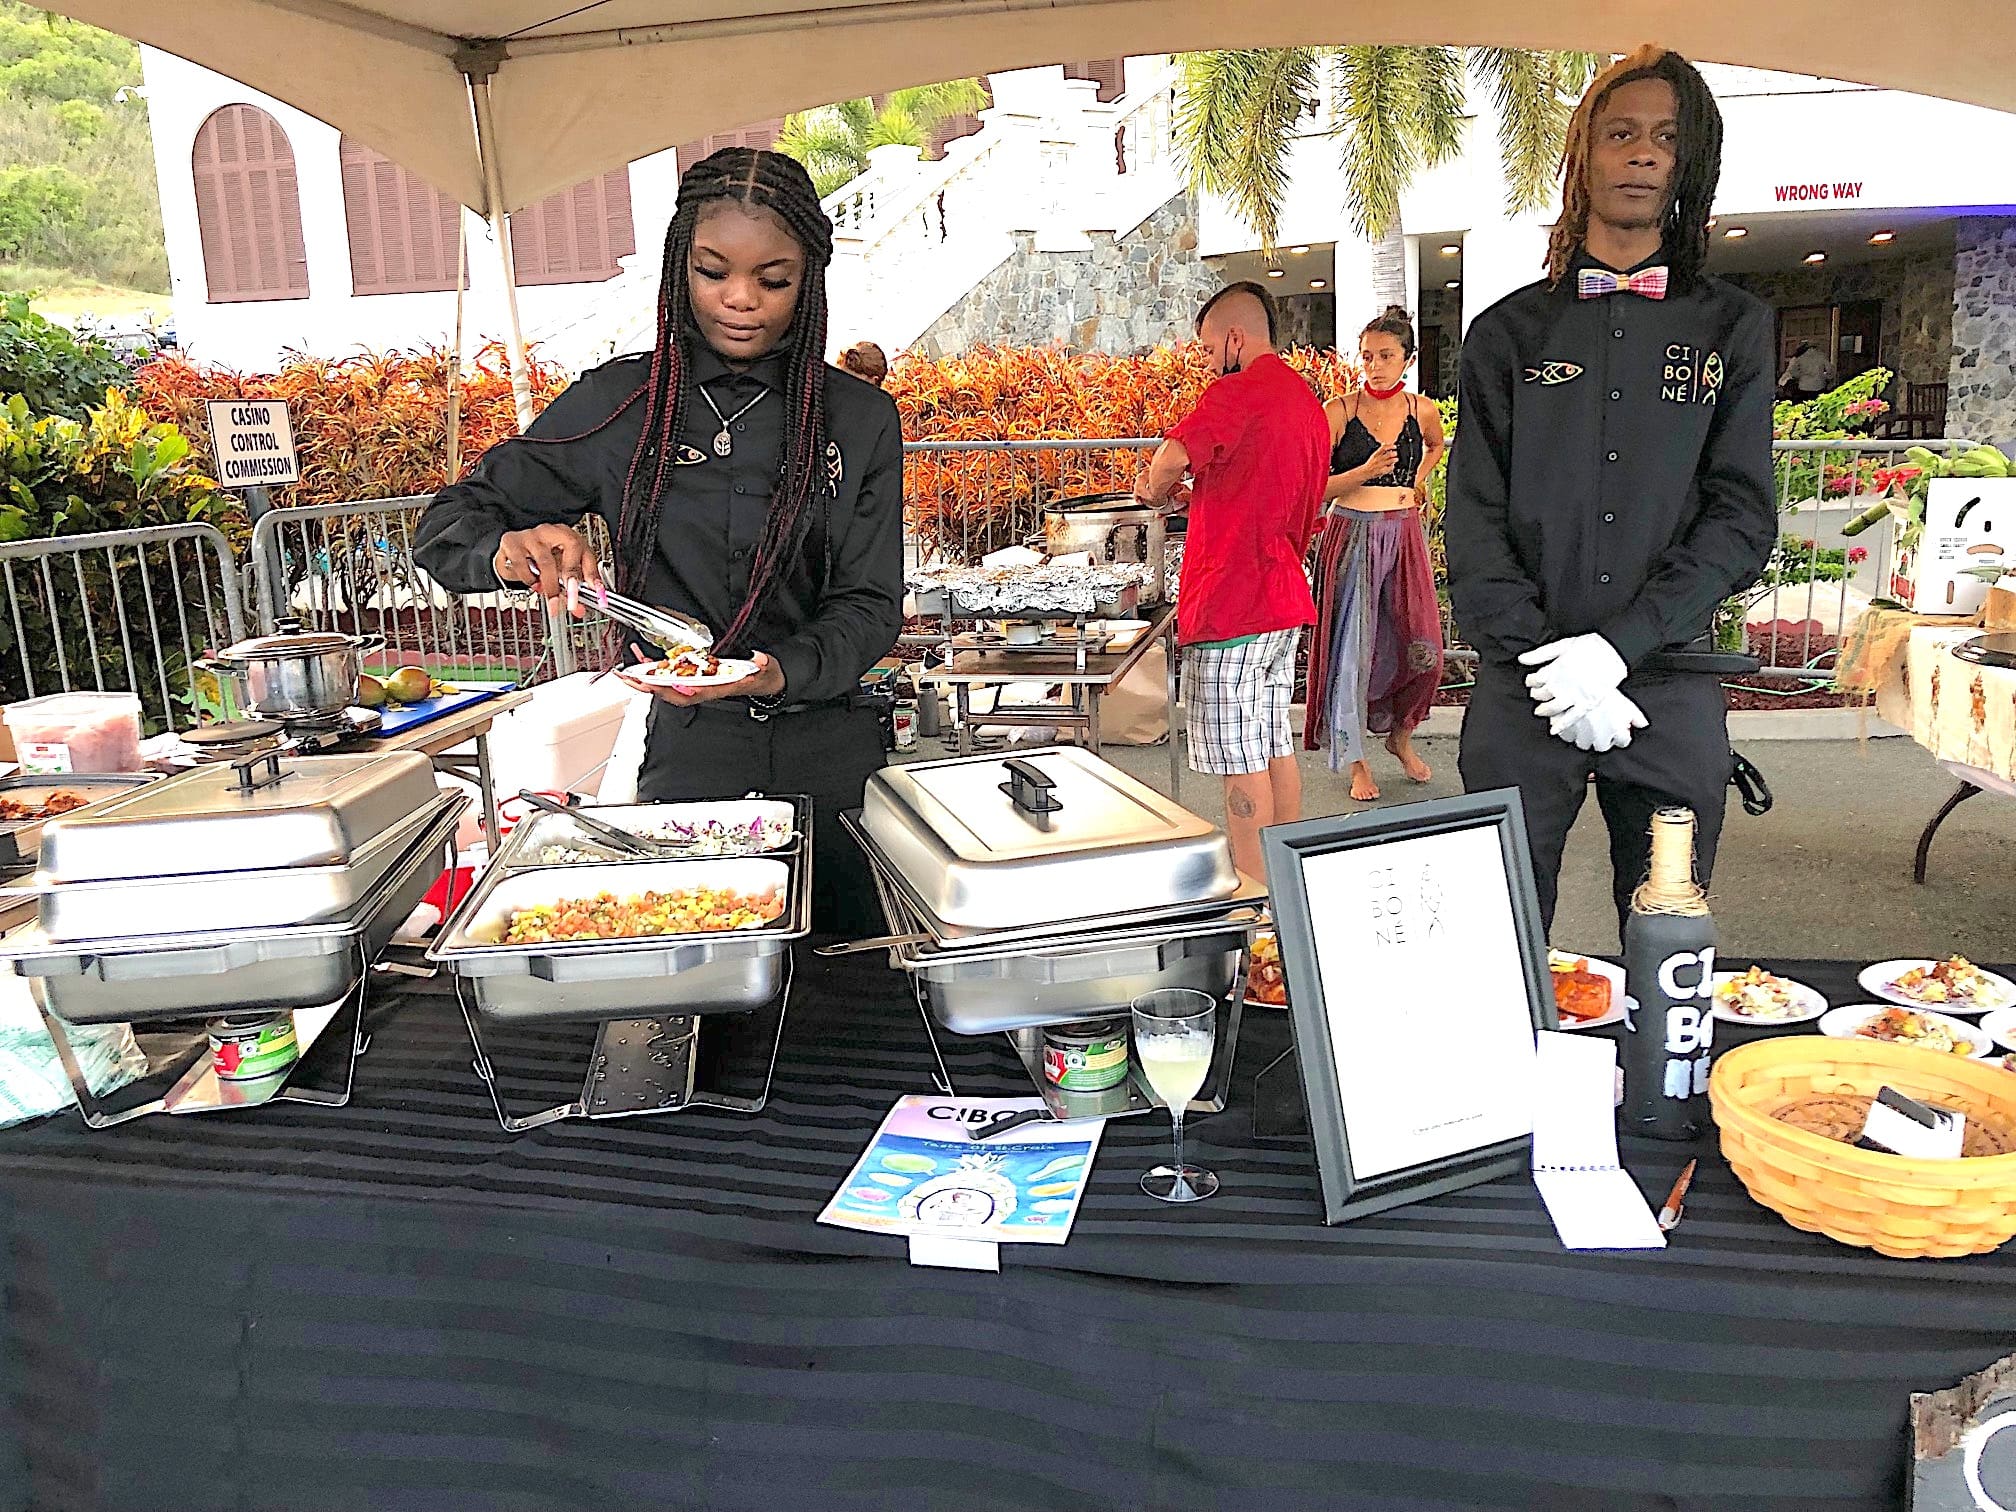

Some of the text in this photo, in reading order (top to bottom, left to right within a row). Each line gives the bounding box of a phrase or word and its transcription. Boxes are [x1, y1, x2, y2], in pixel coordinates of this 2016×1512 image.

[1775, 182, 1862, 201] WRONG WAY
[1666, 344, 1690, 360] CI
[1664, 365, 1691, 381] BO
[231, 407, 270, 425] CASINO
[230, 433, 279, 452] CONTROL
[225, 457, 292, 479] COMMISSION
